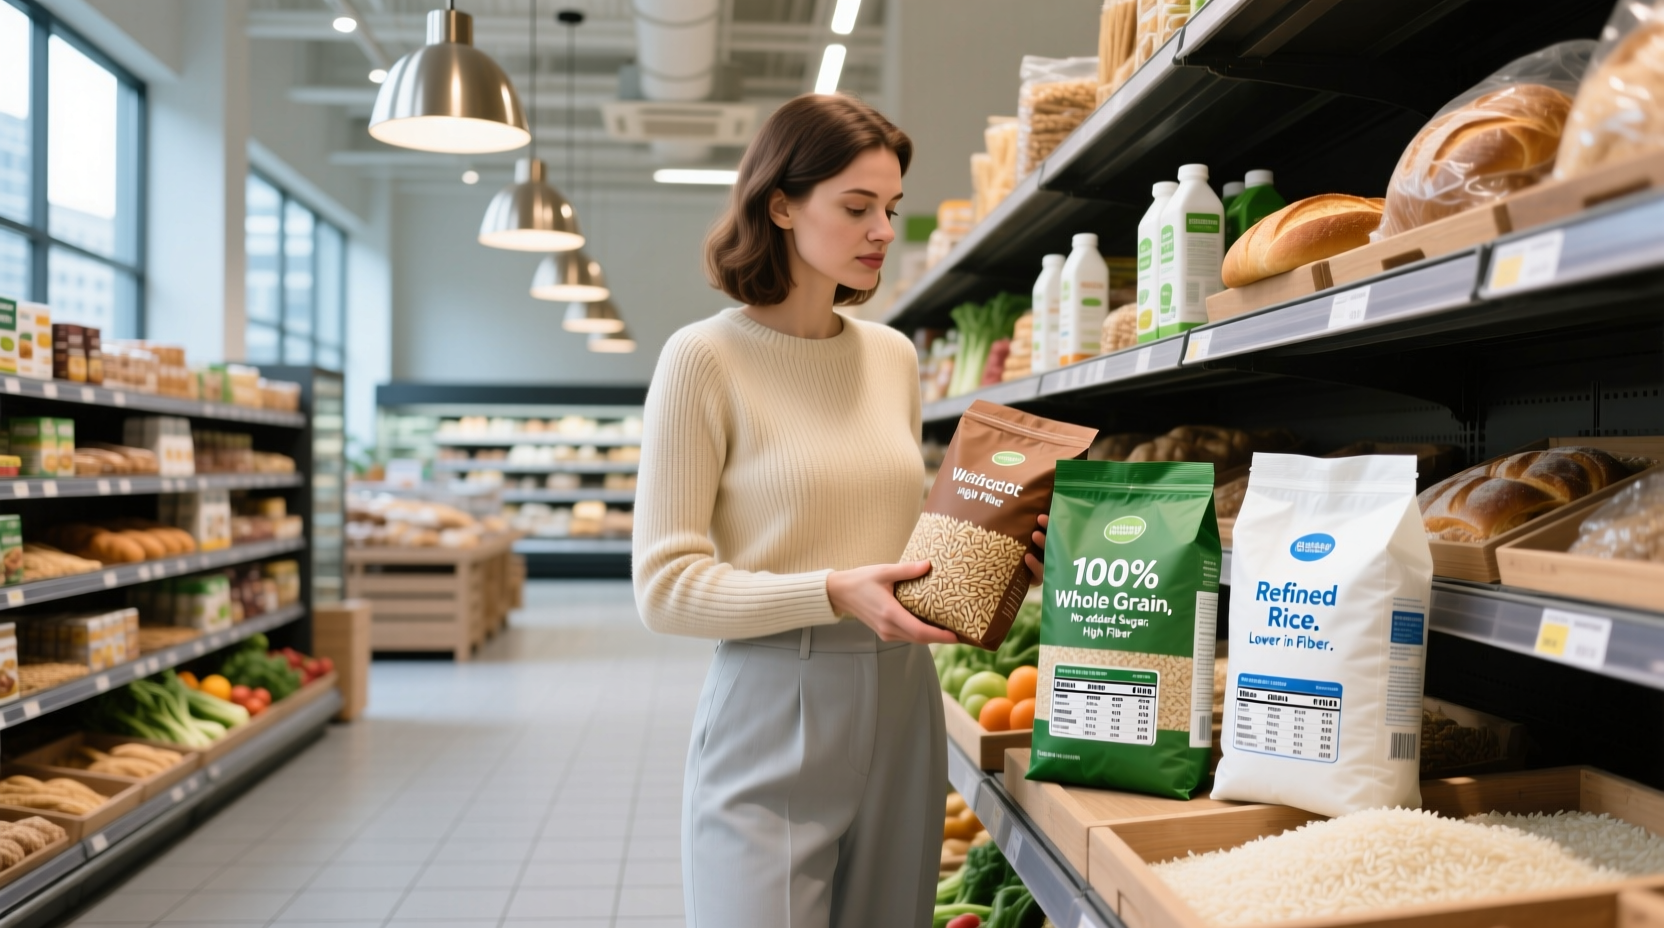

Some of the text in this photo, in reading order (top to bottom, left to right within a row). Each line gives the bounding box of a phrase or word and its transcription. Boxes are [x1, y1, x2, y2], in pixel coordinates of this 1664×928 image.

[1073, 557, 1159, 589] 100%
[1055, 589, 1109, 609] Whole
[1113, 592, 1172, 616] Grain,
[1255, 581, 1338, 606] Refined
[1071, 612, 1084, 623] No
[1268, 606, 1320, 631] Rice.
[1249, 631, 1281, 646] Lower
[1283, 634, 1294, 647] in
